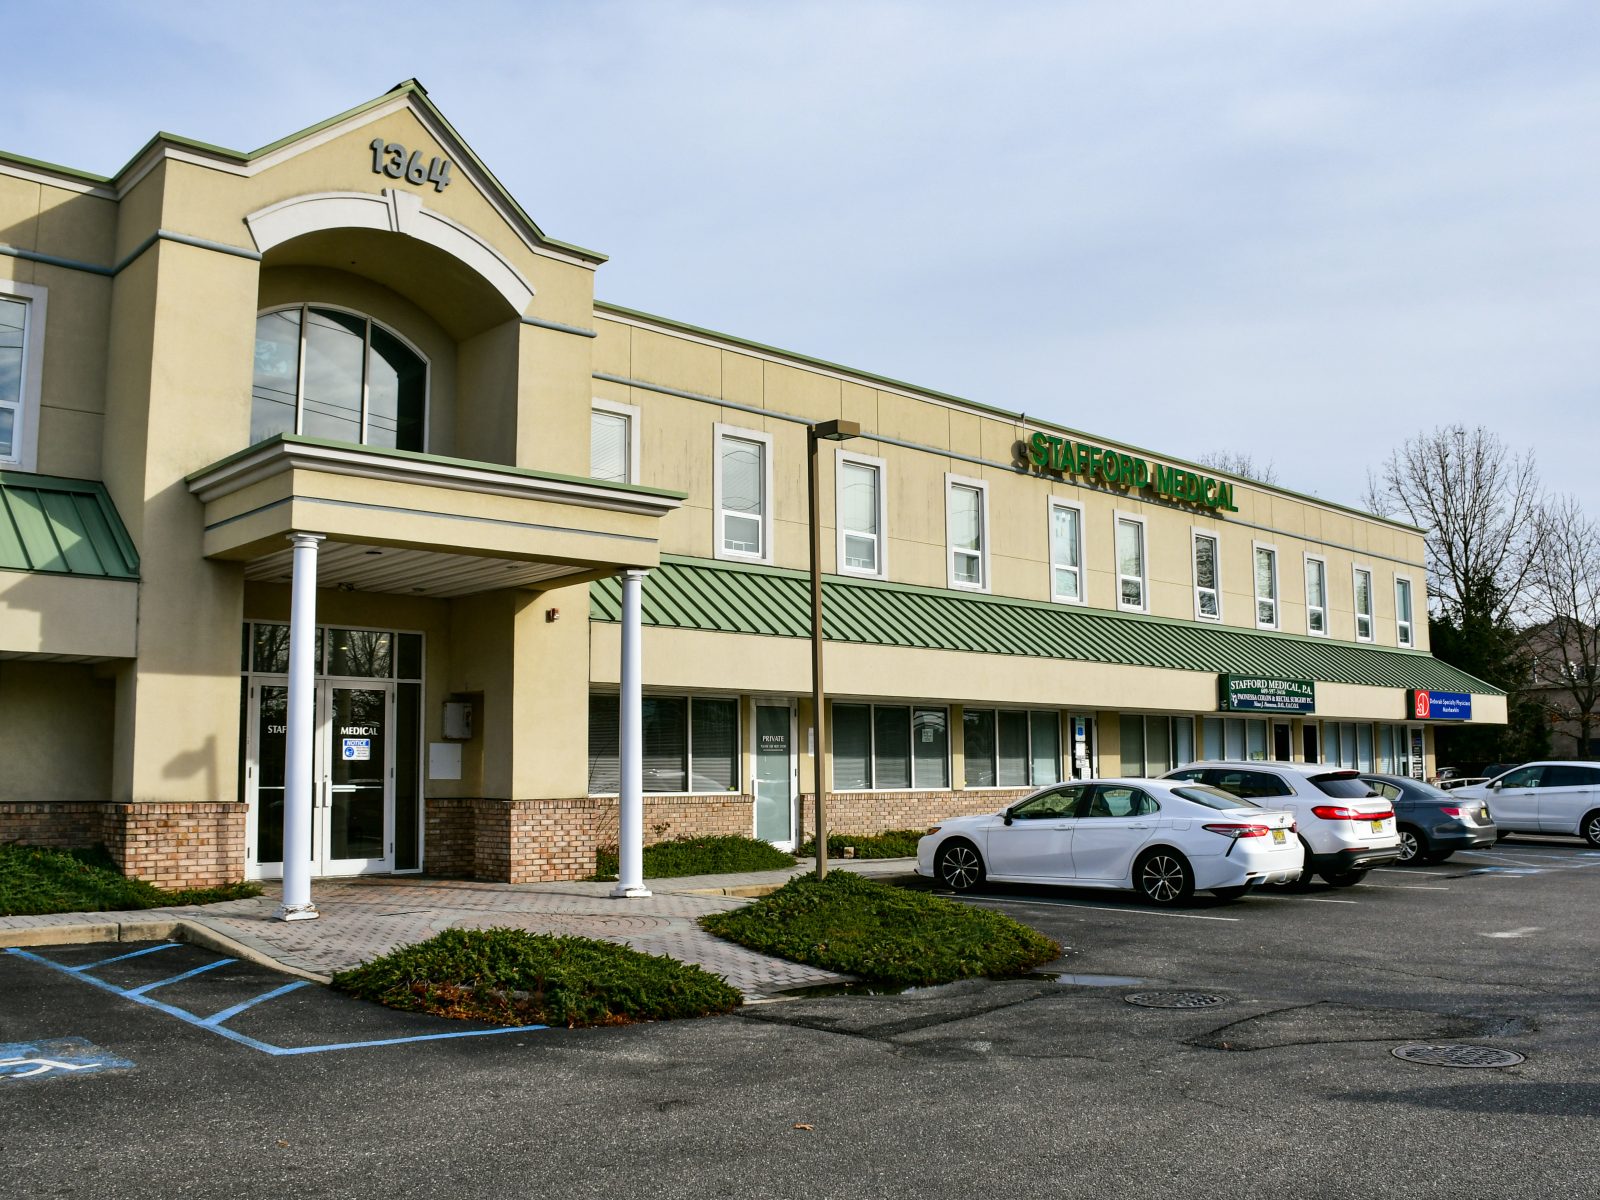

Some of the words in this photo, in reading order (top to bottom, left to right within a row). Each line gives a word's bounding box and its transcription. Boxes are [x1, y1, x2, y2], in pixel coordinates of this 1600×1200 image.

[369, 138, 452, 193] 1364
[1031, 432, 1149, 488] STAFFORD
[1154, 463, 1239, 513] MEDICAL
[1230, 679, 1268, 690] STAFFORD
[1268, 680, 1301, 694] MEDICAL,
[267, 725, 287, 734] STAF
[340, 726, 379, 736] MEDICAL
